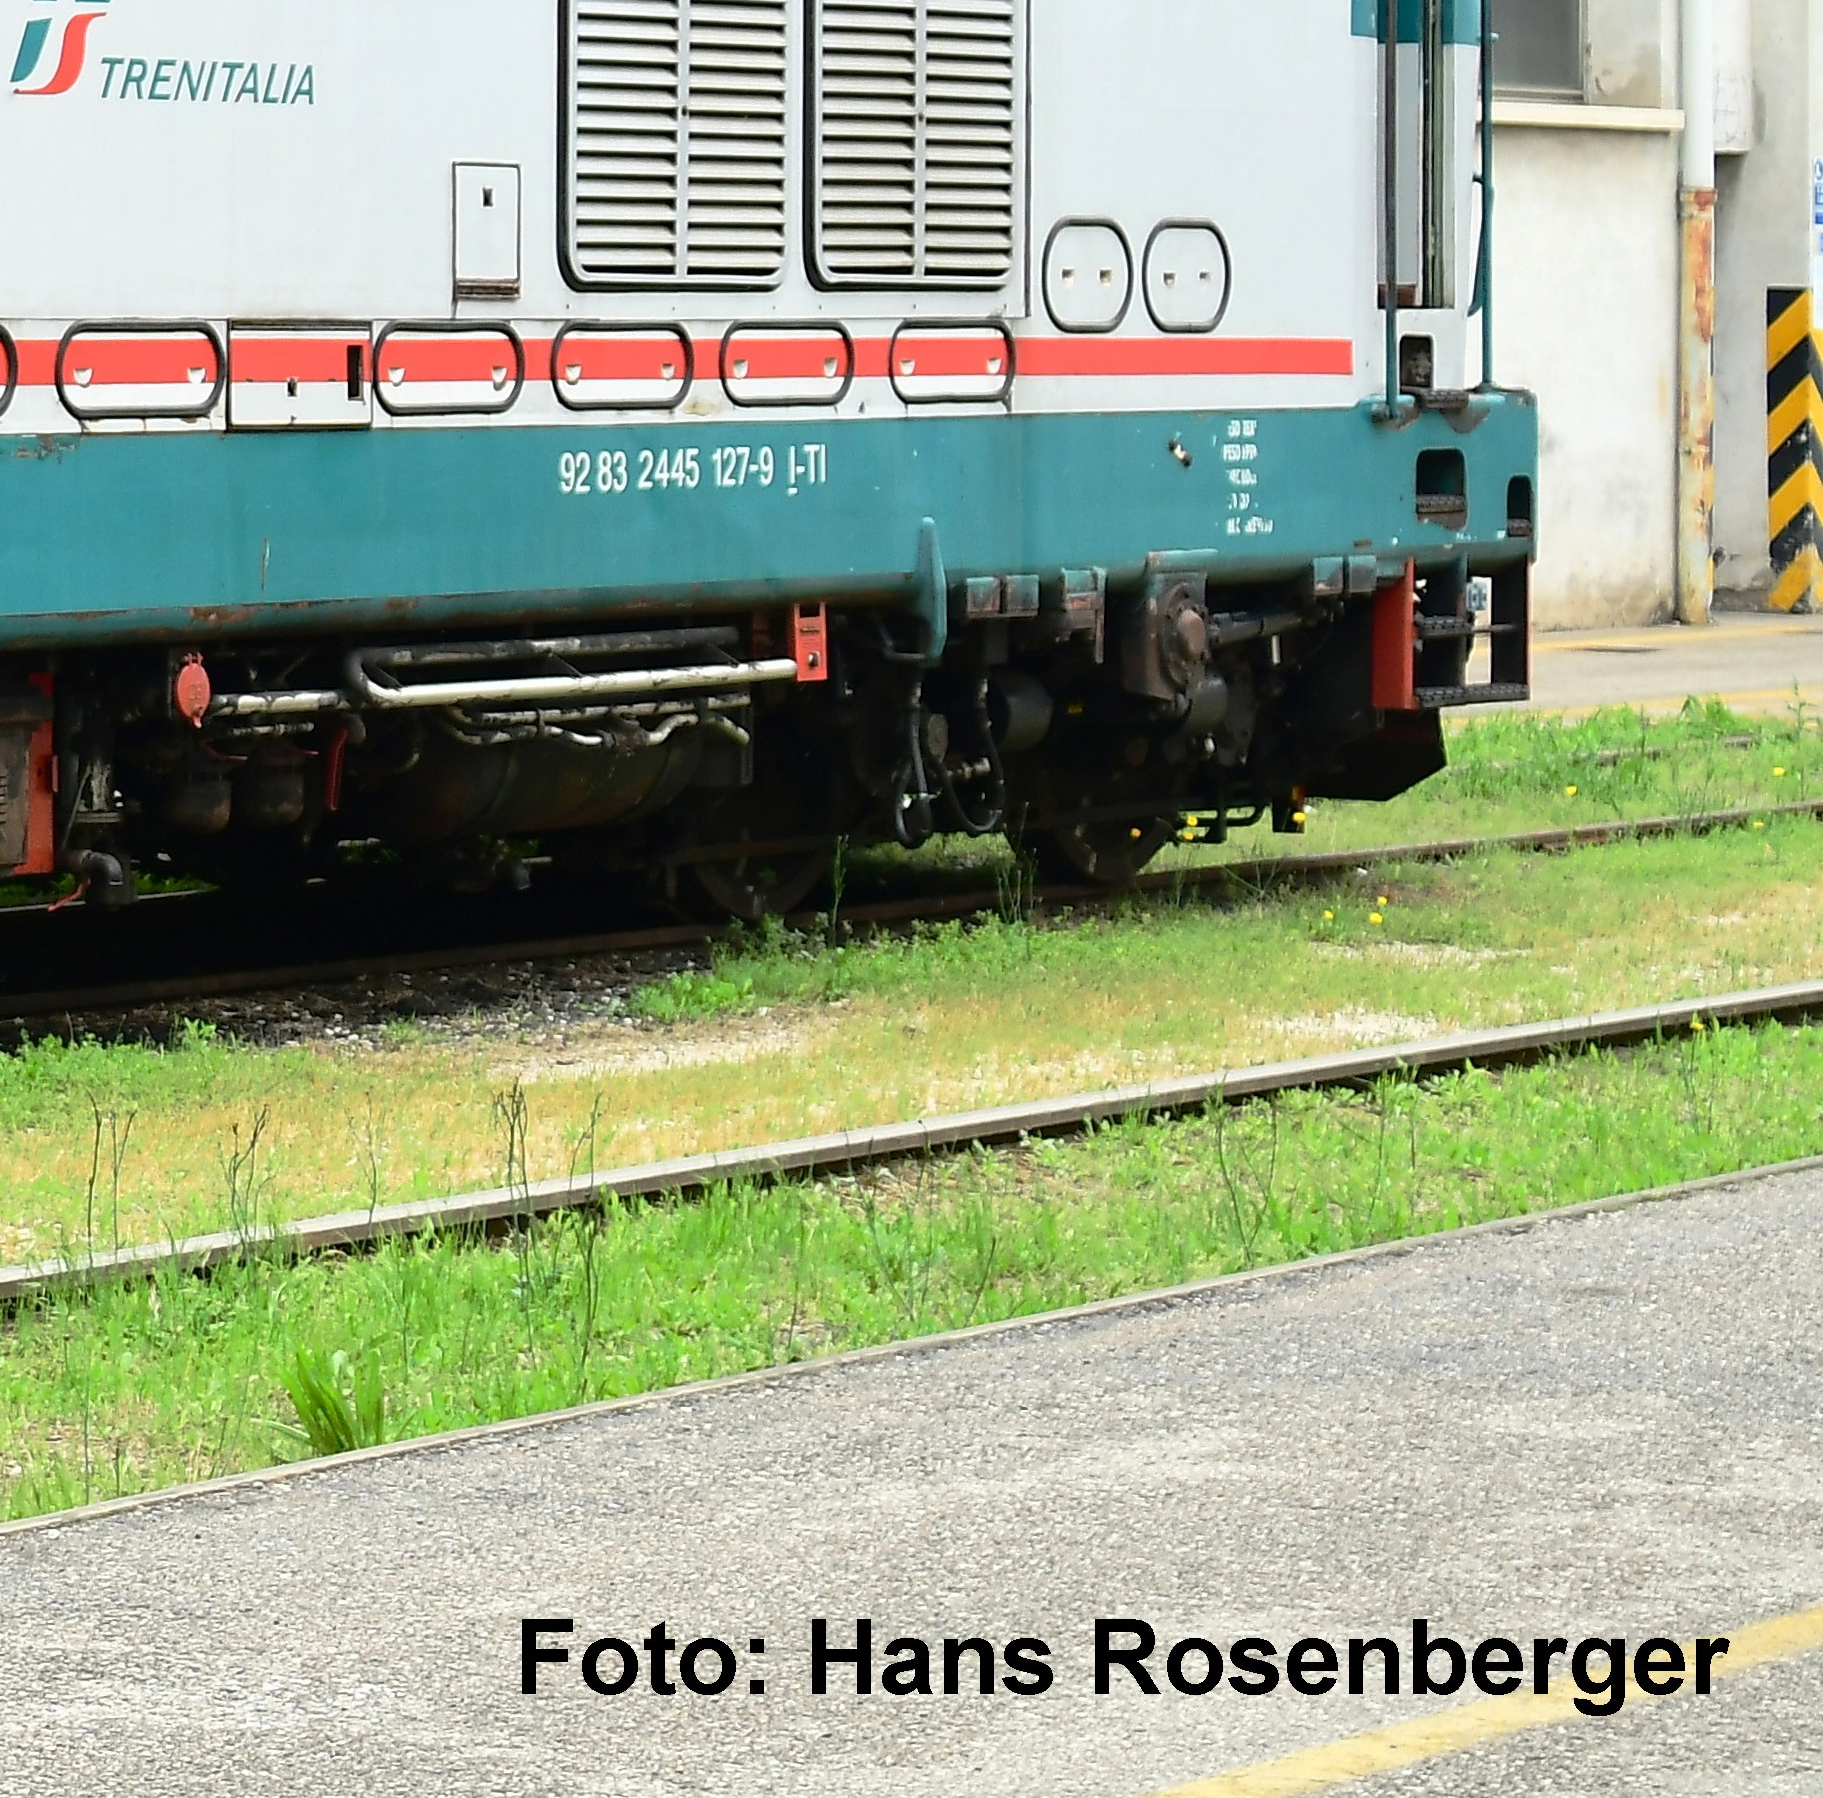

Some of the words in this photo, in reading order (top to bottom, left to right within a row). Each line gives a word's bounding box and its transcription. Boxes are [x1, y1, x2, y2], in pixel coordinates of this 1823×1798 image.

[101, 58, 314, 106] TRENITALIA
[561, 452, 591, 493] 92
[598, 451, 628, 493] 83
[638, 448, 700, 489] 2445
[712, 446, 774, 486] 127-9
